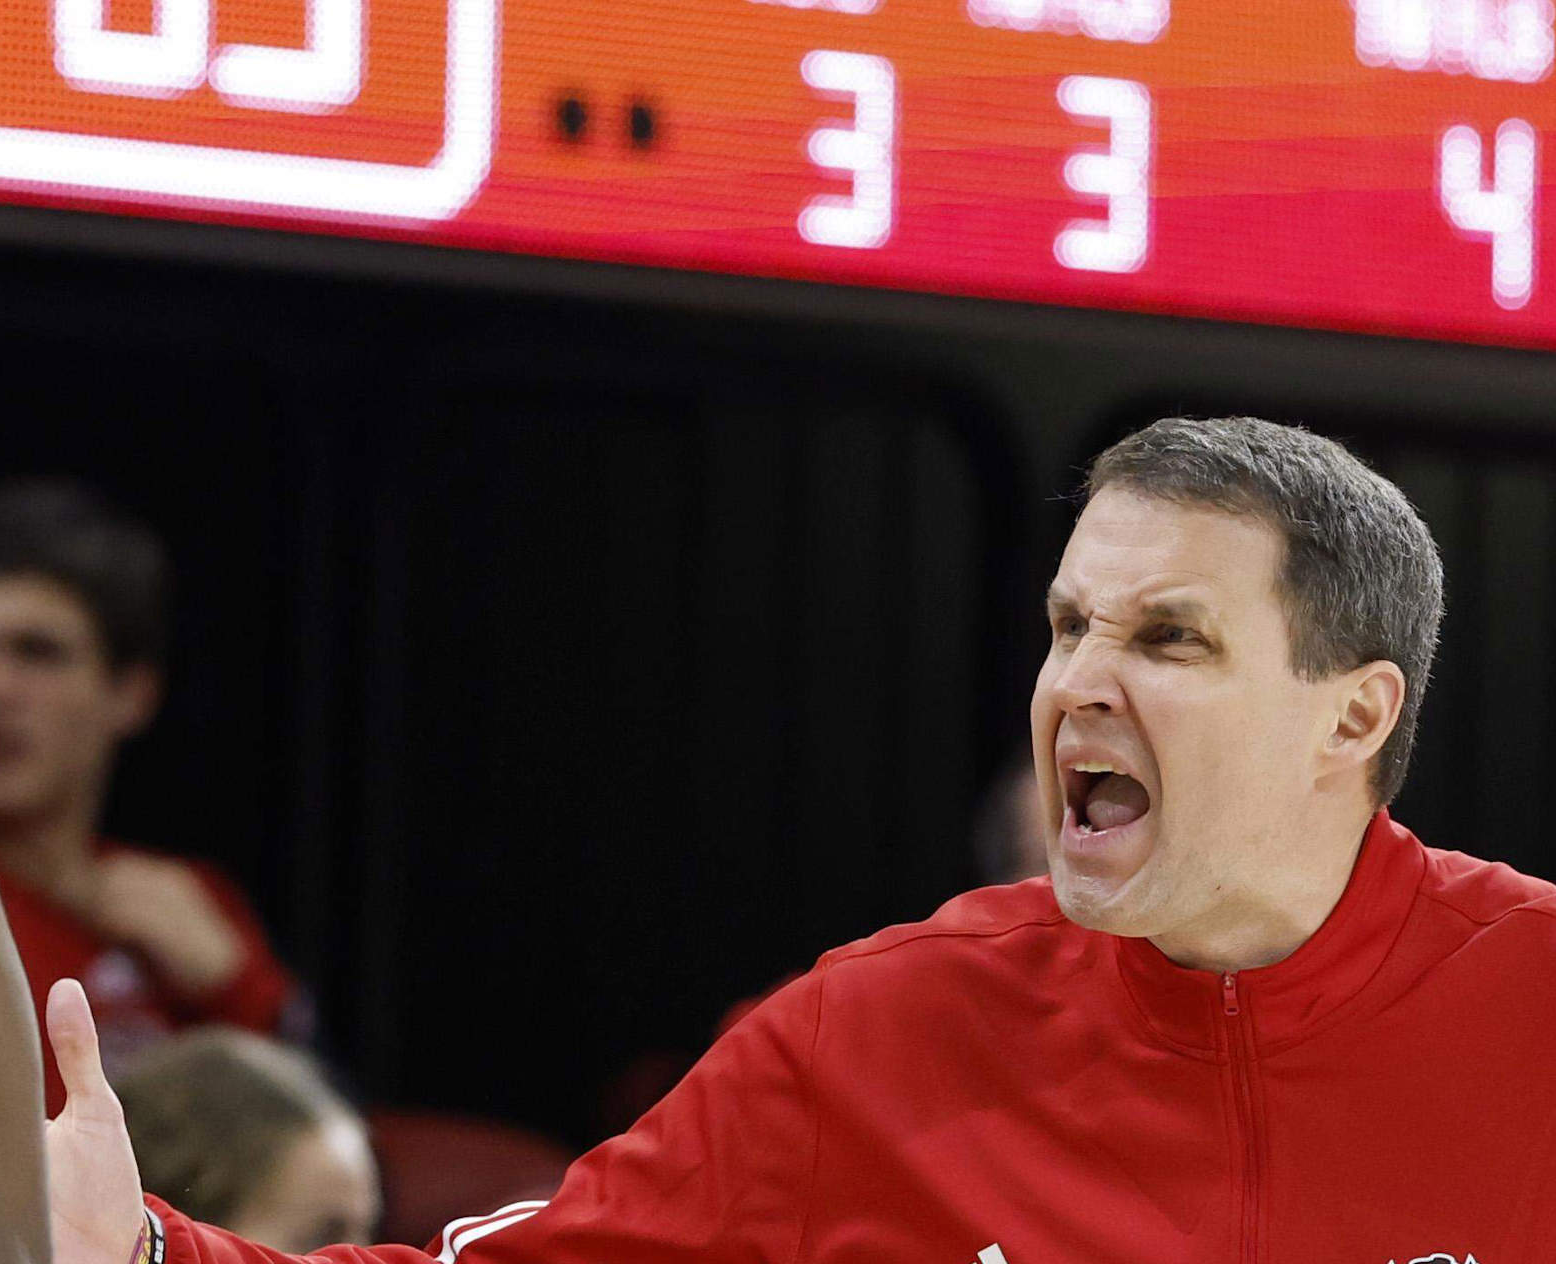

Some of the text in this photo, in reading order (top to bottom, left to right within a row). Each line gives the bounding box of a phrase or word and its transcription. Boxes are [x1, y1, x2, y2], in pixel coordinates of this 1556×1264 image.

[797, 48, 895, 248] 3
[1053, 73, 1151, 273] 3
[1439, 119, 1539, 310] 4
